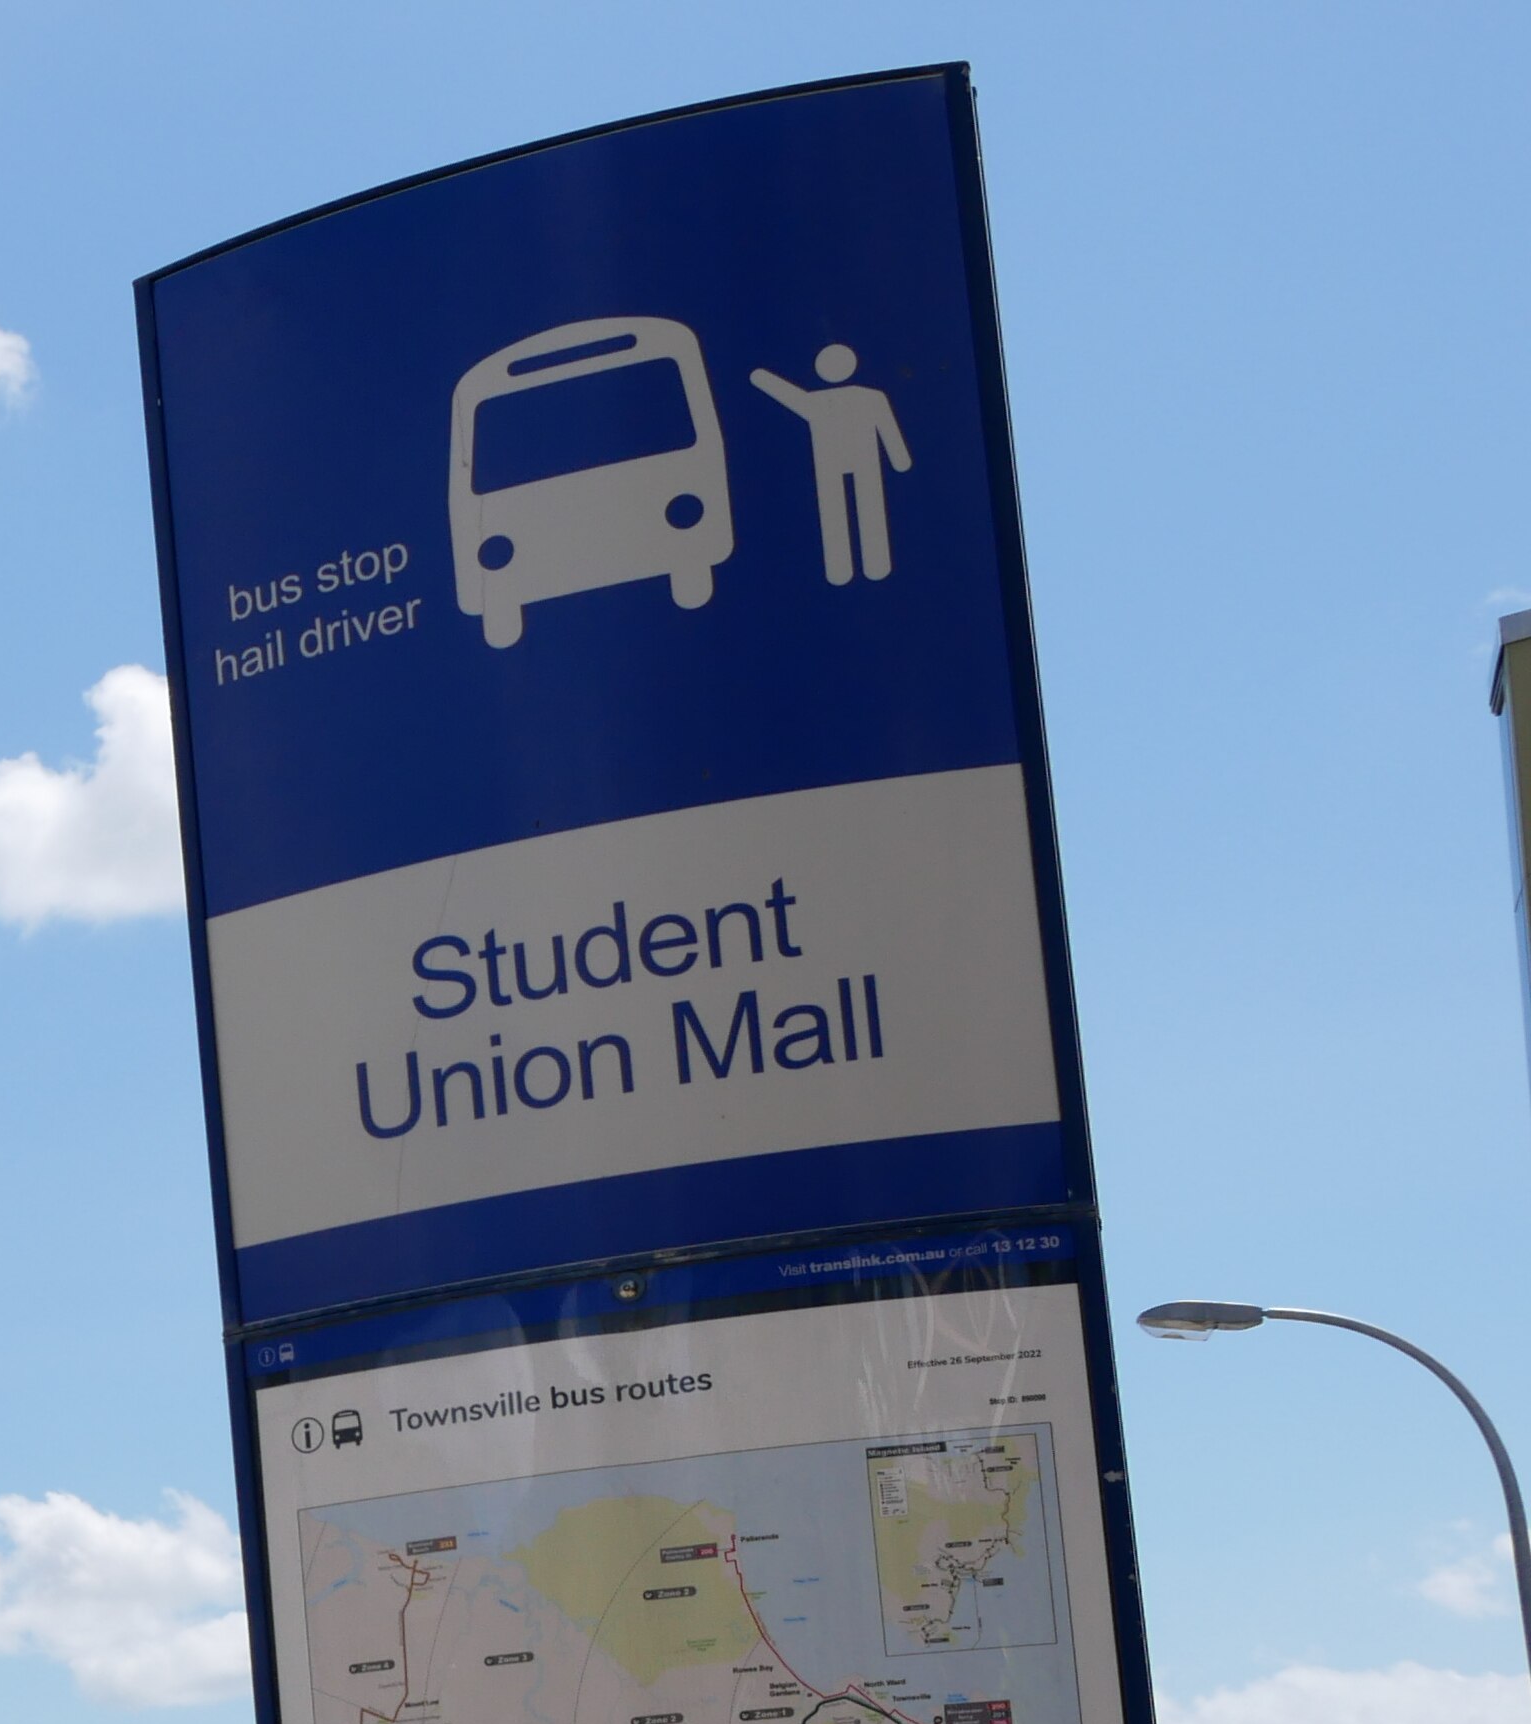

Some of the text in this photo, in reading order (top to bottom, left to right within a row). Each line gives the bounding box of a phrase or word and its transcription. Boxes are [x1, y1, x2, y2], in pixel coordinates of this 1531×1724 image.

[228, 543, 409, 622] bus stop
[215, 598, 422, 686] hail driver
[411, 876, 803, 1020] Student
[355, 974, 884, 1139] Union Mall
[779, 1236, 1060, 1277] Visit translink.com.au or call 13 12 30
[907, 1349, 1042, 1369] Effective 26 September 2022
[389, 1372, 713, 1432] Townsville bus routes
